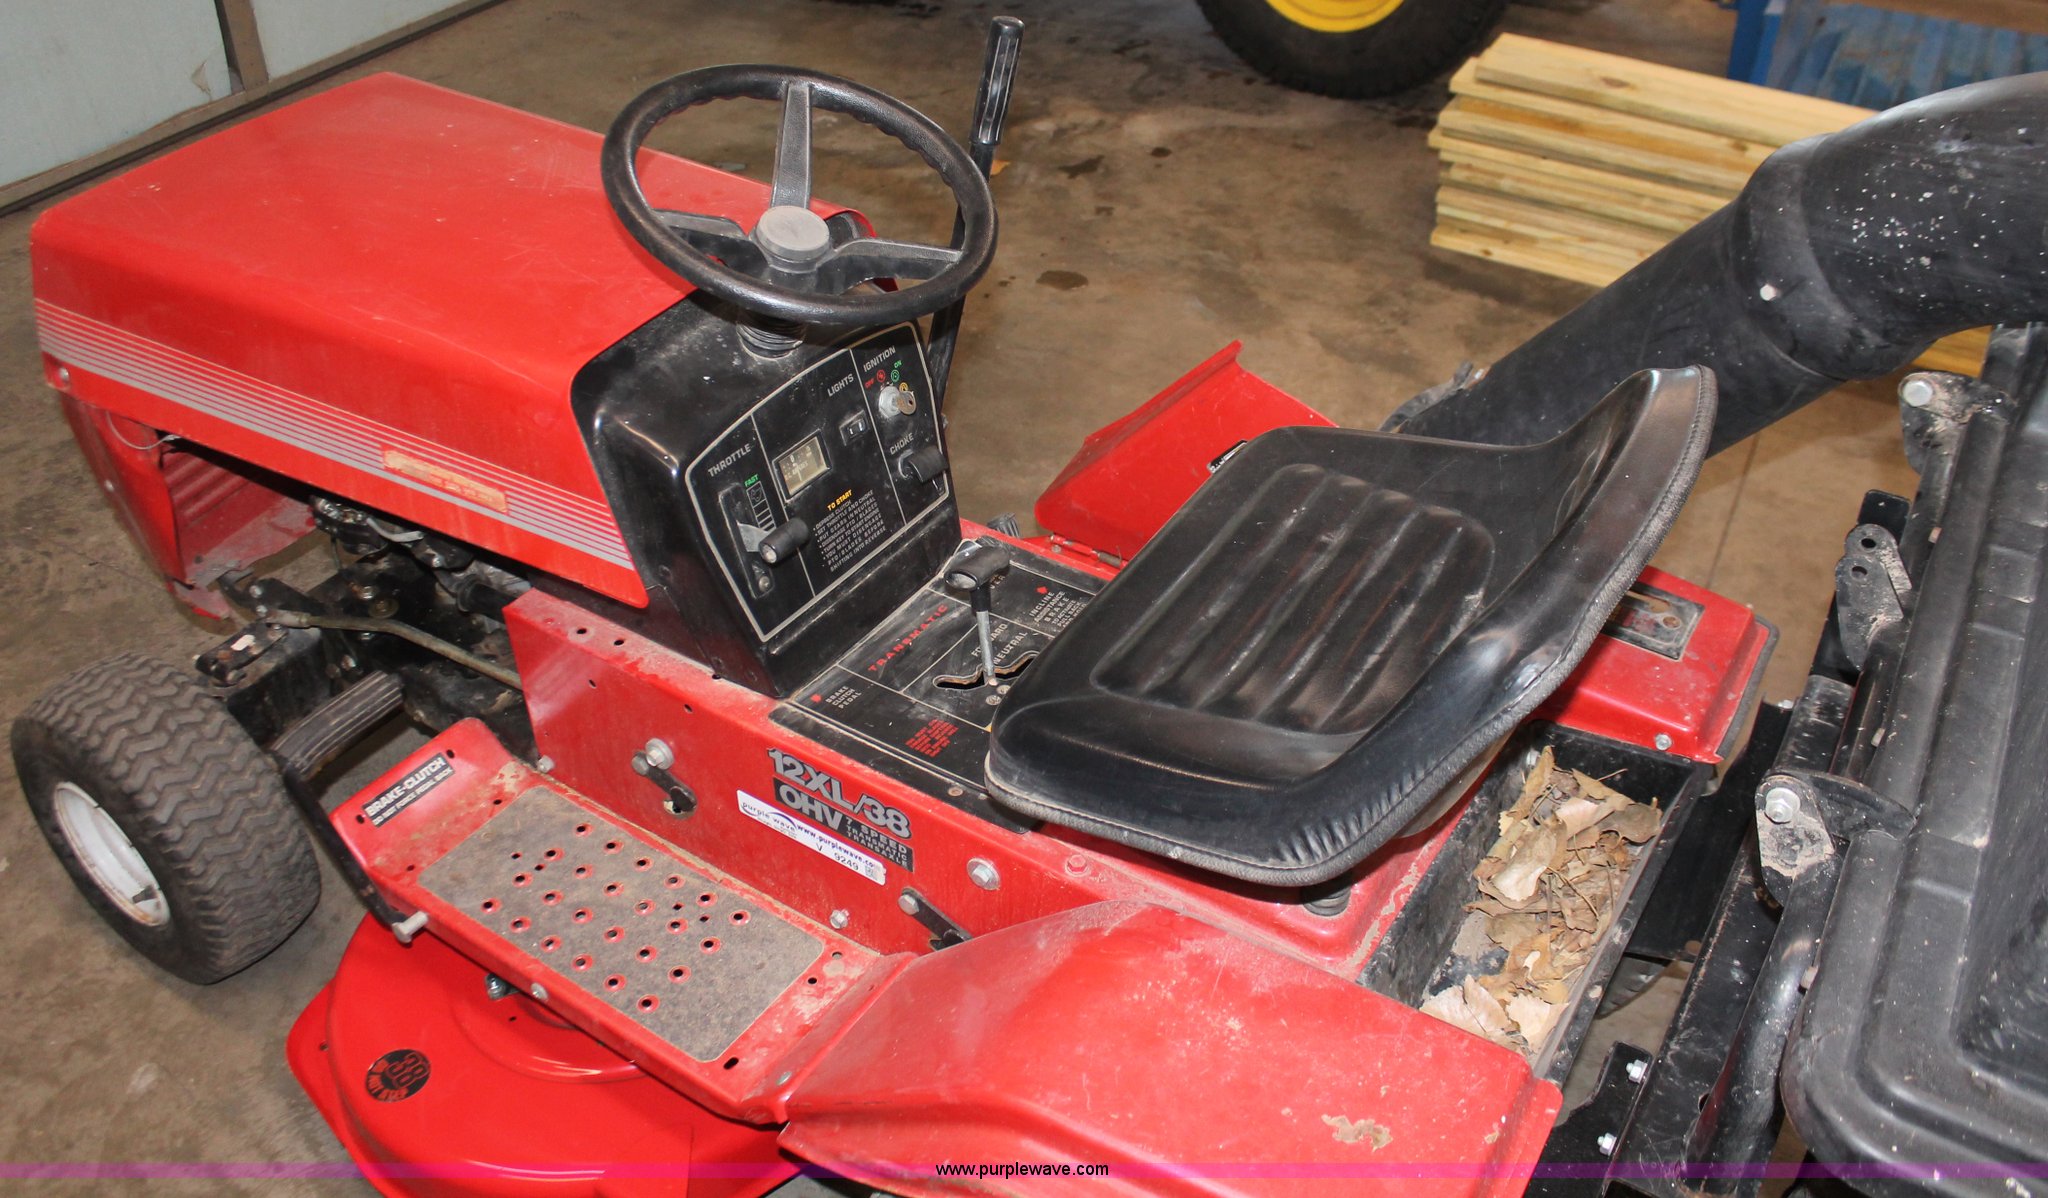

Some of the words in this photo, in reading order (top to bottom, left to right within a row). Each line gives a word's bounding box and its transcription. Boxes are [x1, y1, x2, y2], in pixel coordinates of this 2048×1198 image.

[863, 345, 895, 372] IGNITION
[827, 373, 854, 397] LIGHTS
[889, 432, 914, 455] CHOKE
[708, 443, 751, 477] THROTTLE
[744, 474, 759, 487] FAST
[817, 526, 826, 535] SET
[827, 510, 847, 528] THROTTLE
[848, 501, 858, 511] AND
[858, 490, 873, 503] CHOKE
[828, 503, 836, 511] TO
[836, 489, 852, 505] START
[835, 500, 852, 514] CLUTCH
[846, 519, 855, 528] PTO
[859, 502, 878, 518] BLADES
[819, 531, 829, 541] PUT
[830, 518, 847, 533] GEARS
[847, 511, 854, 519] IN
[853, 496, 875, 515] NEUTRAL
[836, 535, 845, 544] KEY
[851, 519, 864, 532] START
[864, 520, 883, 537] BEFORE
[825, 548, 836, 559] YOU
[836, 536, 851, 550] MUST
[852, 513, 881, 538] DISENGAGE
[830, 552, 853, 572] SHIFTING
[852, 542, 864, 553] INTO
[865, 526, 886, 544] REVERSE
[1029, 592, 1055, 617] INCLINE
[1034, 591, 1065, 622] ATANCE
[1044, 597, 1069, 622] BRAKE
[1057, 615, 1071, 626] PULL
[1068, 602, 1082, 614] BACK
[868, 605, 947, 671] TRANSMATIC
[971, 623, 1008, 657] FOARD
[993, 632, 1028, 664] NEUTRAL
[825, 686, 849, 703] BRAKE
[832, 689, 855, 706] CLUTCH
[838, 692, 862, 709] PEDAL
[364, 757, 446, 817] BRAKE-CLUTCH
[767, 748, 911, 840] 12XL/38
[742, 802, 770, 818] purple
[773, 817, 796, 832] wave
[779, 784, 842, 831] OHV
[797, 824, 880, 869] www.purplewave.co
[815, 843, 823, 852] V
[845, 816, 852, 826] 7
[860, 823, 907, 854] SPEED
[846, 825, 907, 861] TRANSMATIC
[846, 831, 907, 868] TRANSAXLE
[834, 853, 859, 871] 9249
[386, 1051, 429, 1089] 38
